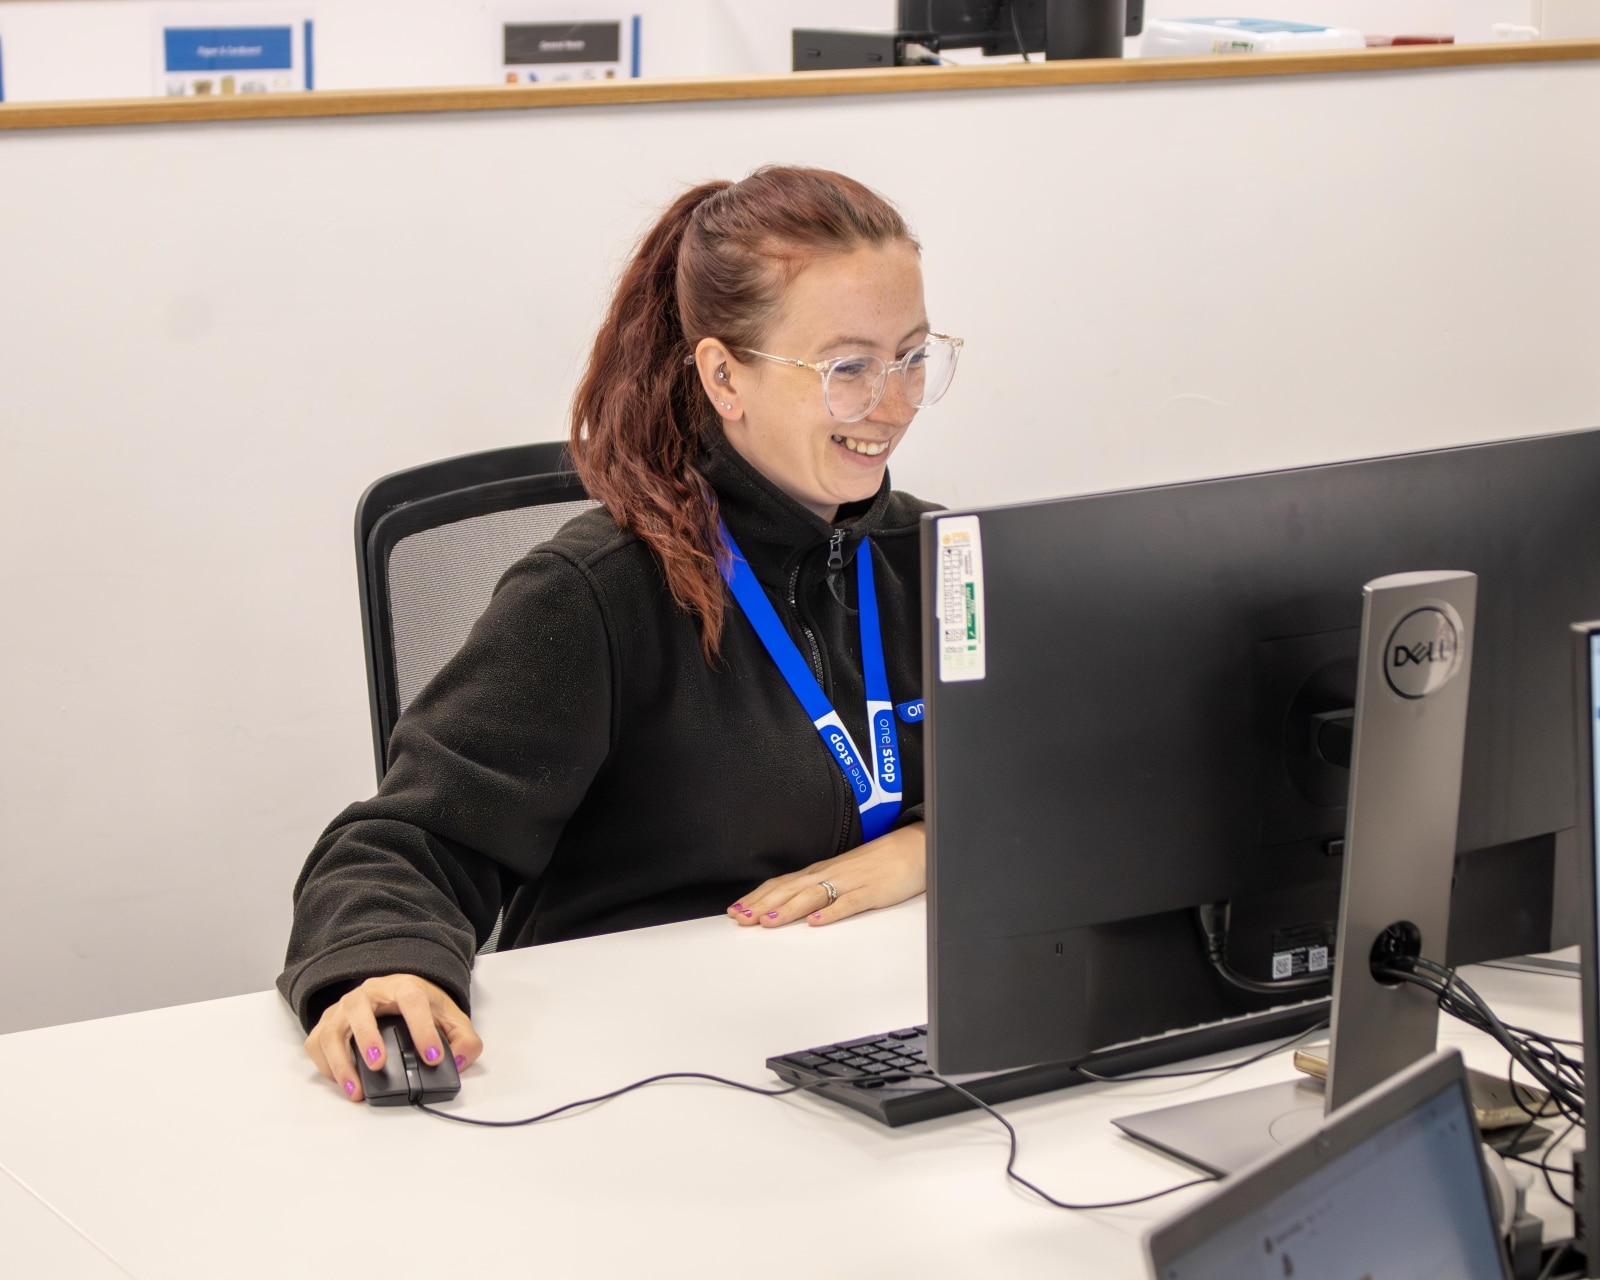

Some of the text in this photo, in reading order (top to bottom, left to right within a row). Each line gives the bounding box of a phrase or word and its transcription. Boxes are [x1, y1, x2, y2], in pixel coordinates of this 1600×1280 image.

[1394, 641, 1448, 667] DELL
[830, 733, 867, 793] one stop
[879, 718, 896, 783] one stop
